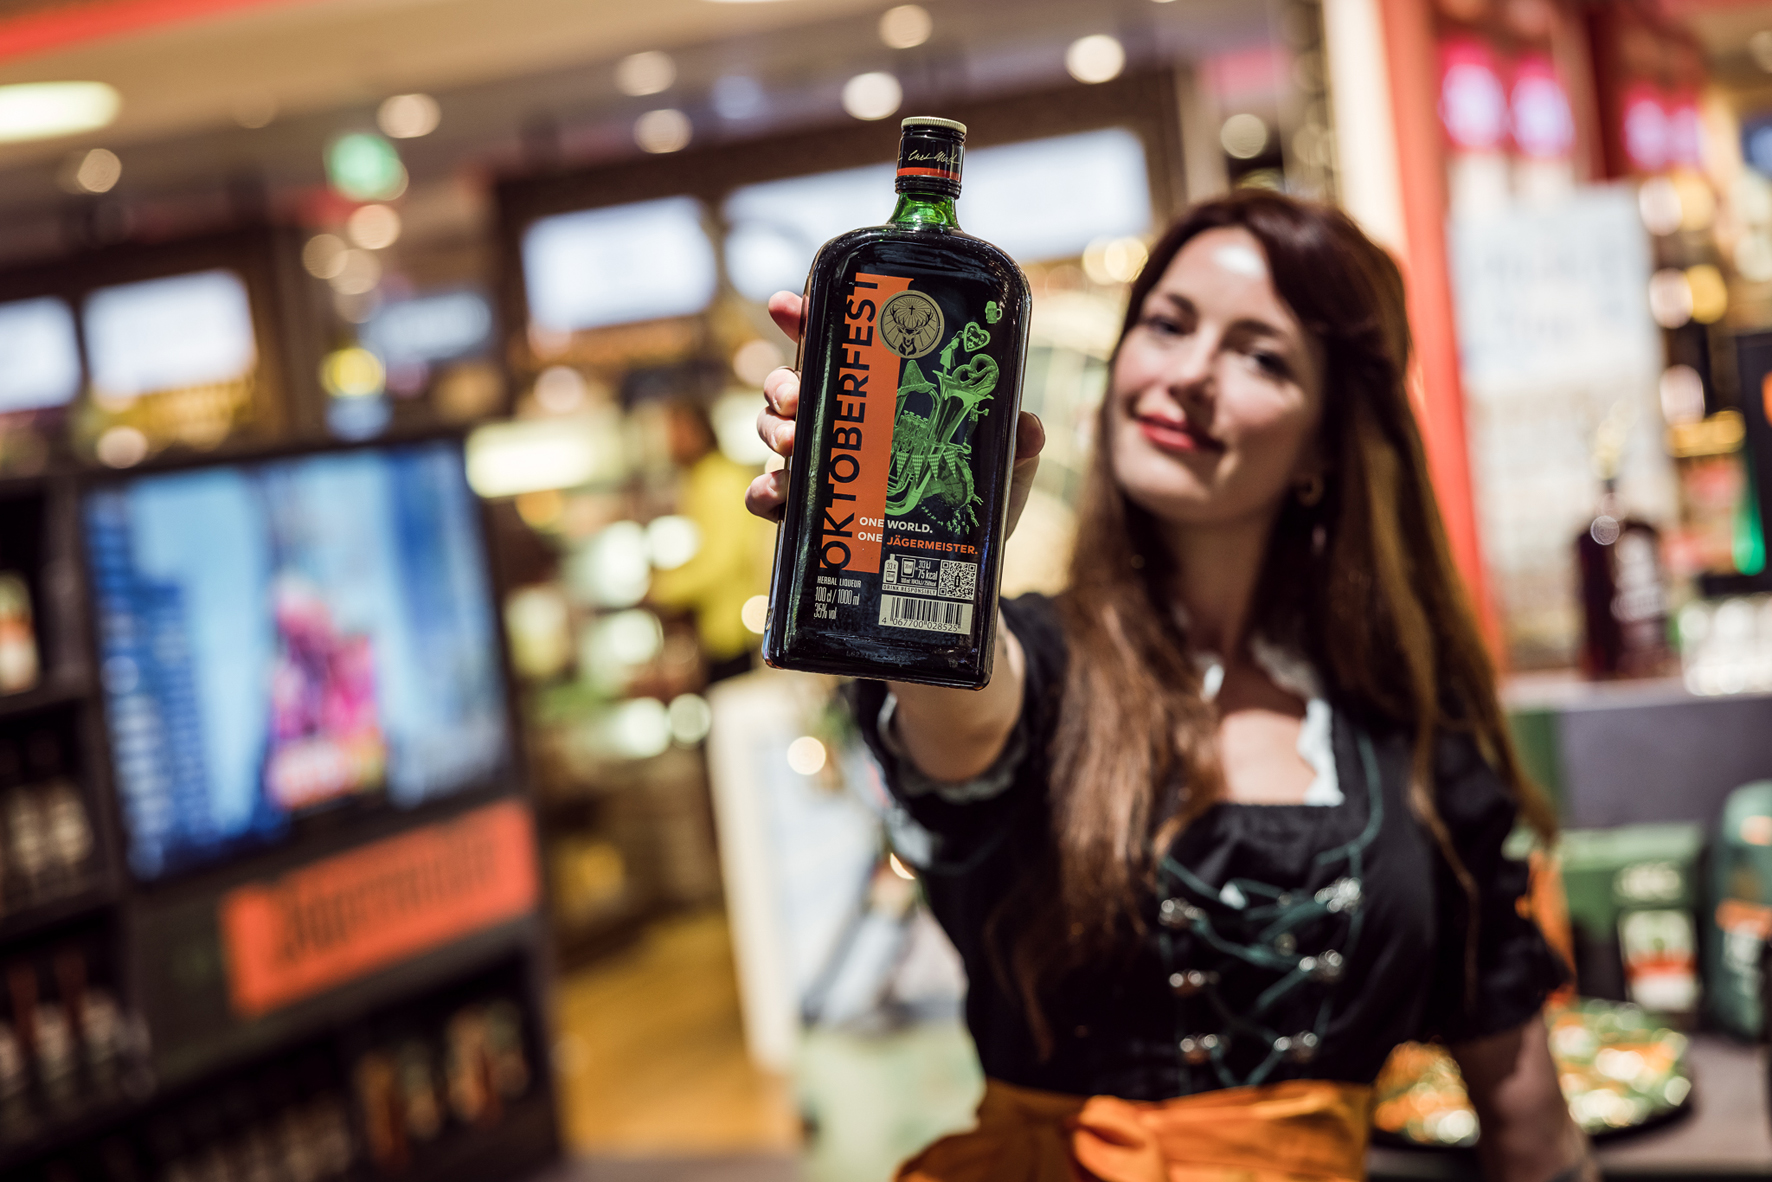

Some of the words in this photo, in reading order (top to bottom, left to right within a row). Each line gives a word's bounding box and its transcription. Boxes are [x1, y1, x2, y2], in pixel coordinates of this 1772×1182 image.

[820, 272, 879, 571] OKTOBERFEST
[859, 516, 885, 528] ONE
[887, 519, 933, 534] WORLD.
[857, 531, 883, 543] ONE
[886, 534, 978, 555] JÄGERMEISTER.
[817, 575, 838, 586] HERBAL
[839, 578, 862, 588] LIQUEUR
[918, 569, 925, 579] 75
[815, 586, 827, 602] 100
[837, 588, 853, 605] 1000
[901, 586, 936, 595] RESPONSIBLY
[813, 602, 828, 619] 35%
[881, 616, 887, 624] 4
[892, 618, 924, 629] 067700
